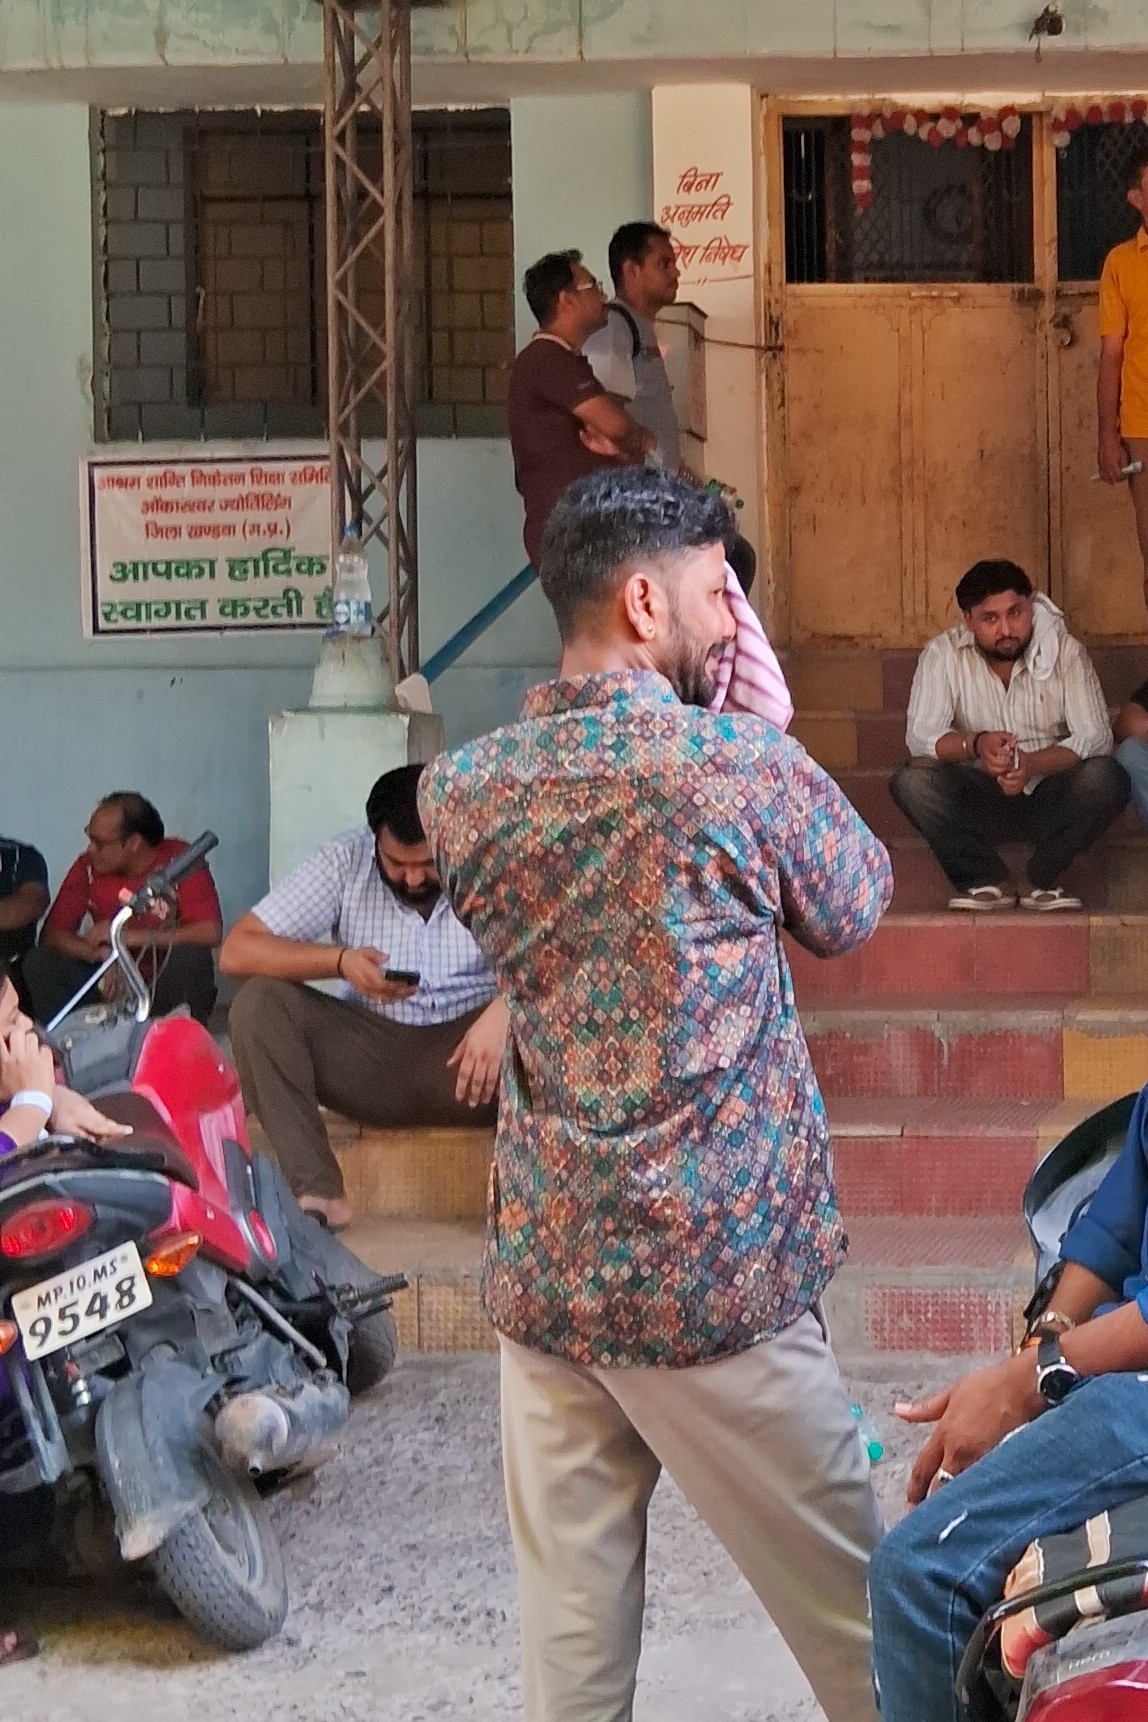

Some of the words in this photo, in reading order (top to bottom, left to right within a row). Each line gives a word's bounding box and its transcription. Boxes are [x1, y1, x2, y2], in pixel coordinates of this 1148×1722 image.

[676, 166, 724, 195] बिना
[109, 557, 218, 584] आपका
[226, 546, 329, 583] हार्दिक
[100, 598, 209, 625] स्वागत
[218, 586, 307, 620] करती
[28, 1274, 138, 1348] 9548
